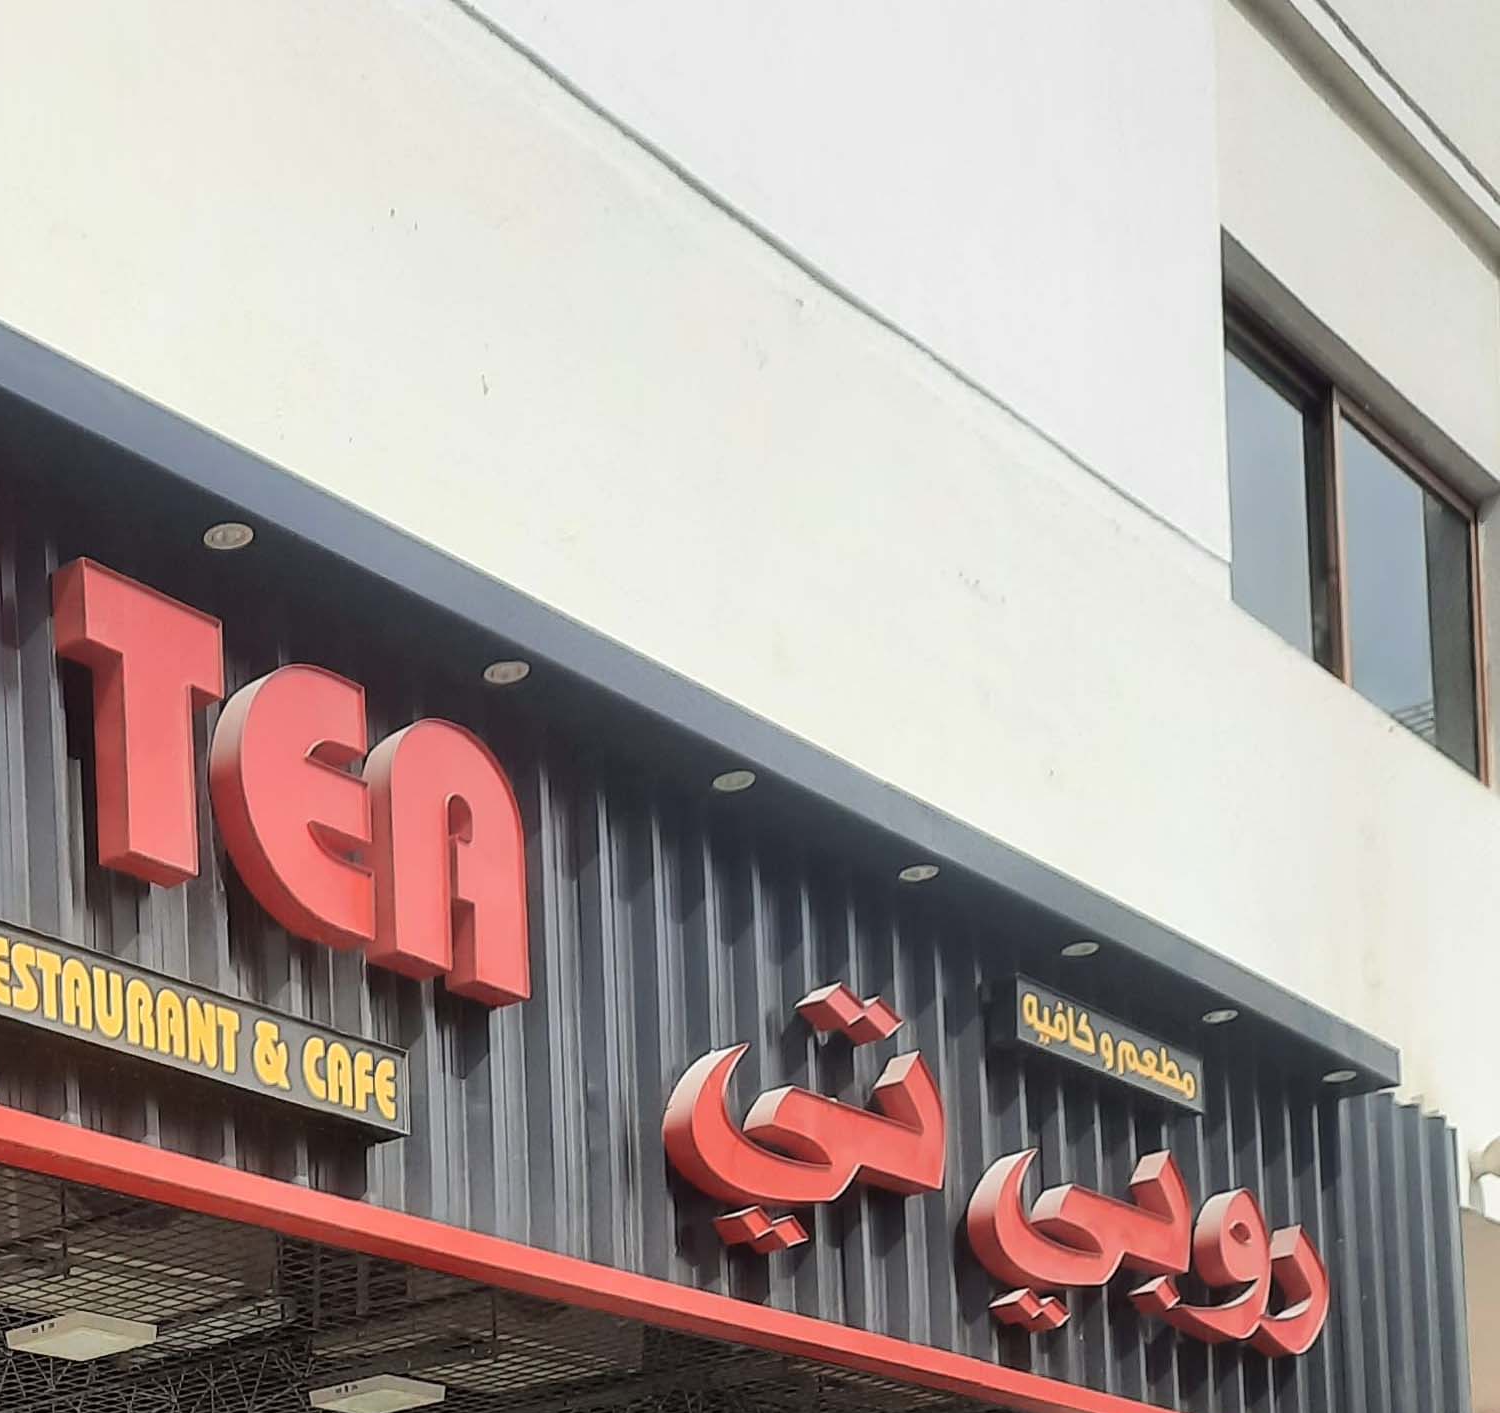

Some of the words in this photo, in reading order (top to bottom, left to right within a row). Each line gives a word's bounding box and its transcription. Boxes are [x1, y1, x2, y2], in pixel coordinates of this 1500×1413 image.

[53, 556, 530, 1008] TEA
[1021, 992, 1097, 1055] كافيه
[251, 1017, 292, 1092] &
[301, 1034, 398, 1123] CAFE
[1116, 1038, 1197, 1100] مطعم
